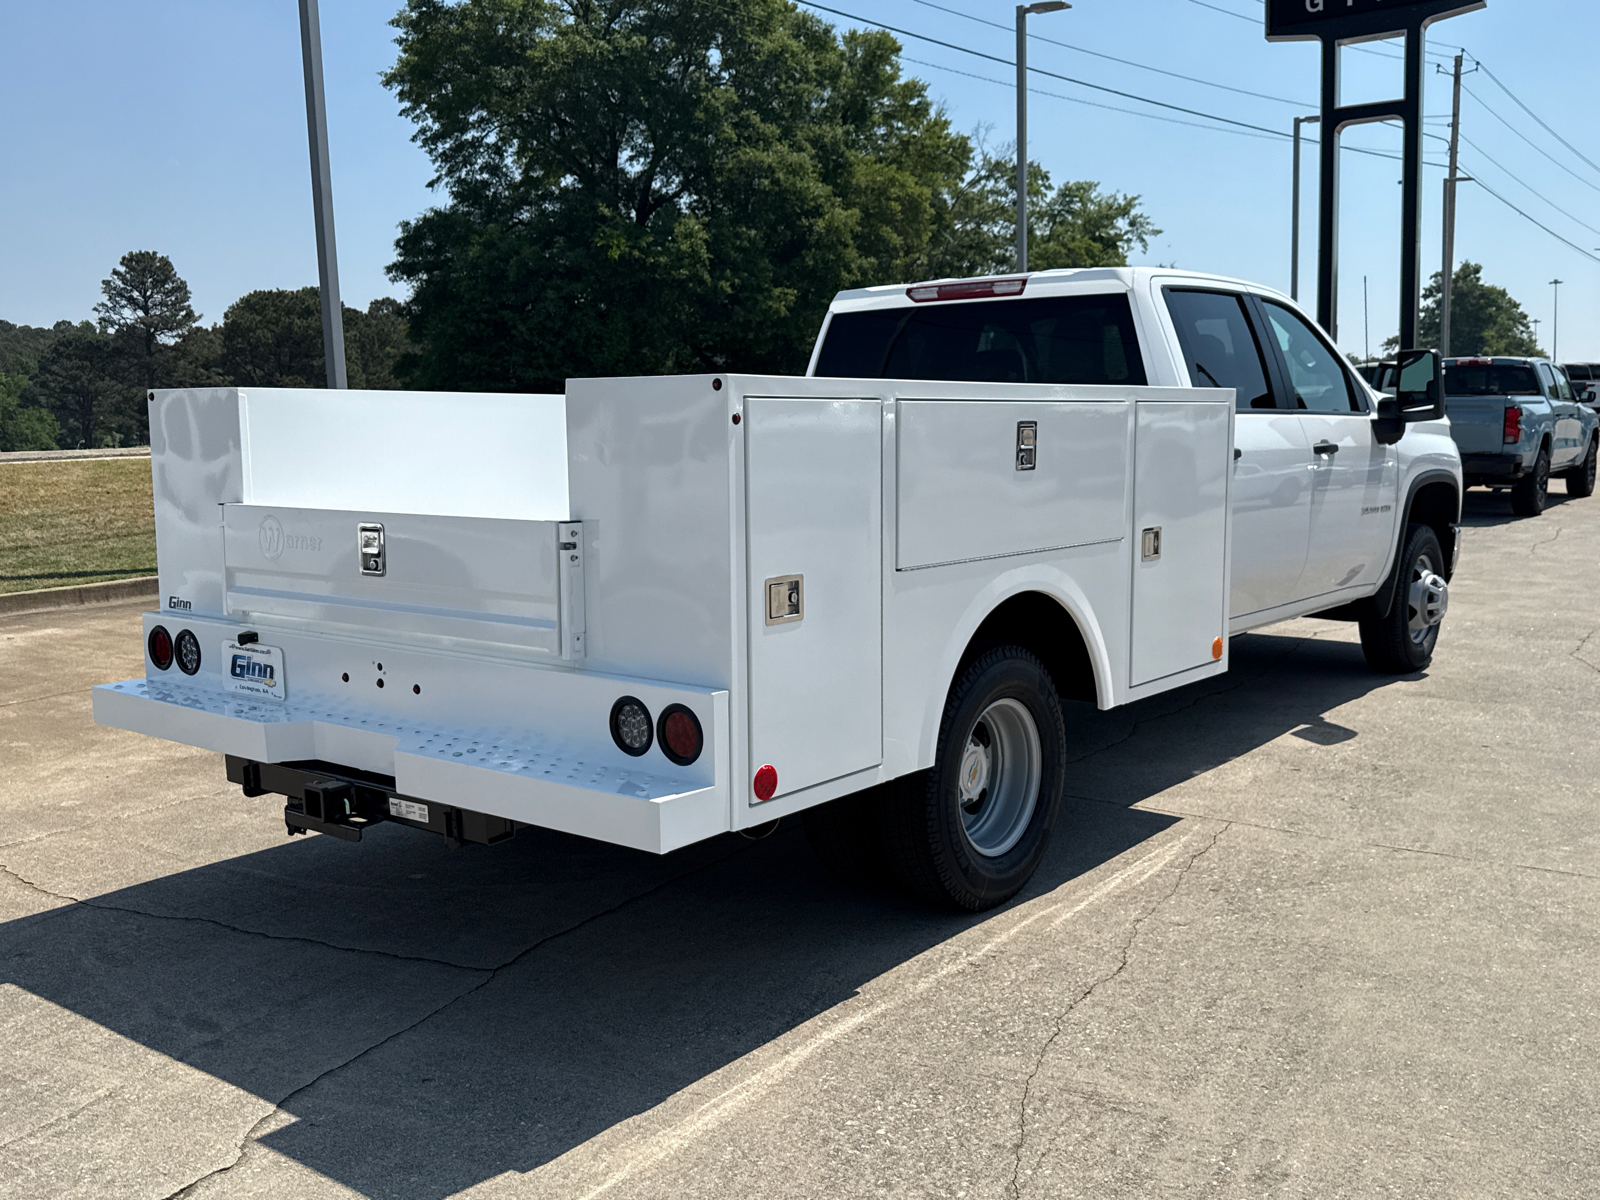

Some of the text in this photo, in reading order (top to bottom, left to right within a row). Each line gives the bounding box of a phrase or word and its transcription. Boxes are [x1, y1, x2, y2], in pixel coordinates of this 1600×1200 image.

[261, 526, 323, 552] Warner
[168, 595, 192, 610] Ginn
[230, 653, 275, 679] Ginn
